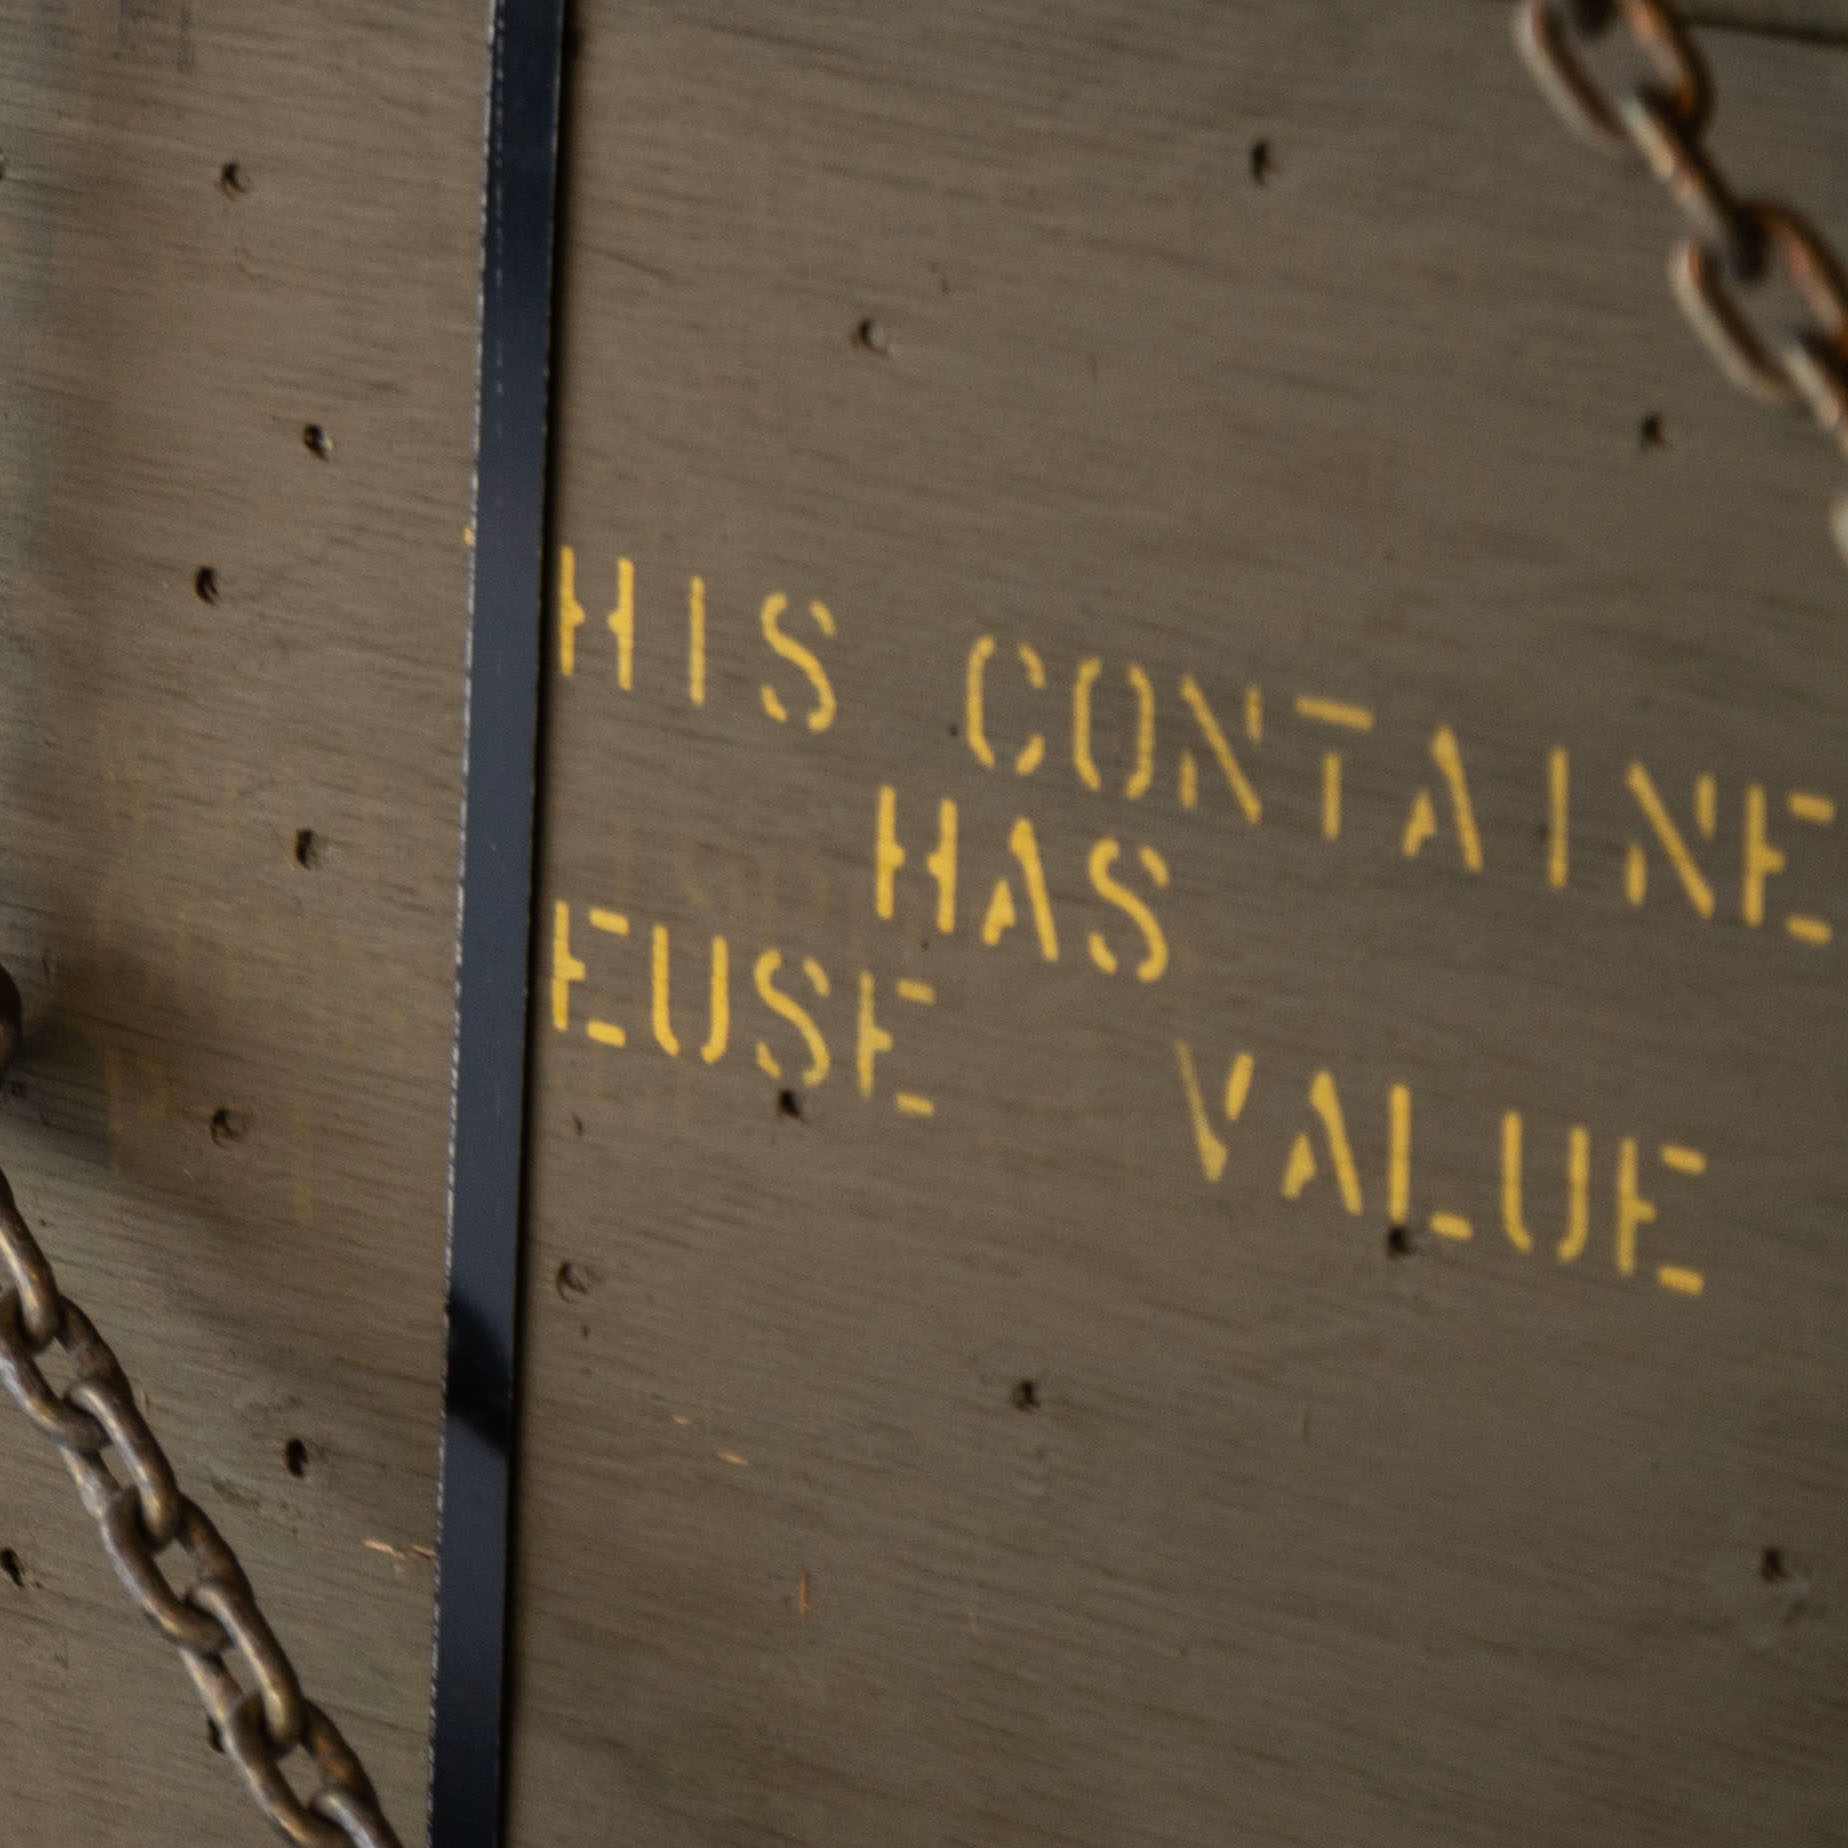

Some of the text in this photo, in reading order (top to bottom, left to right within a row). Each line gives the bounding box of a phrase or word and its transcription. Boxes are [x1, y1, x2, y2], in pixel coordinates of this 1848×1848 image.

[553, 542, 1836, 947] HIS CONTAINE
[873, 782, 1170, 983] HAS
[550, 898, 936, 1118] EUSE
[1177, 1040, 1706, 1296] VALUE
